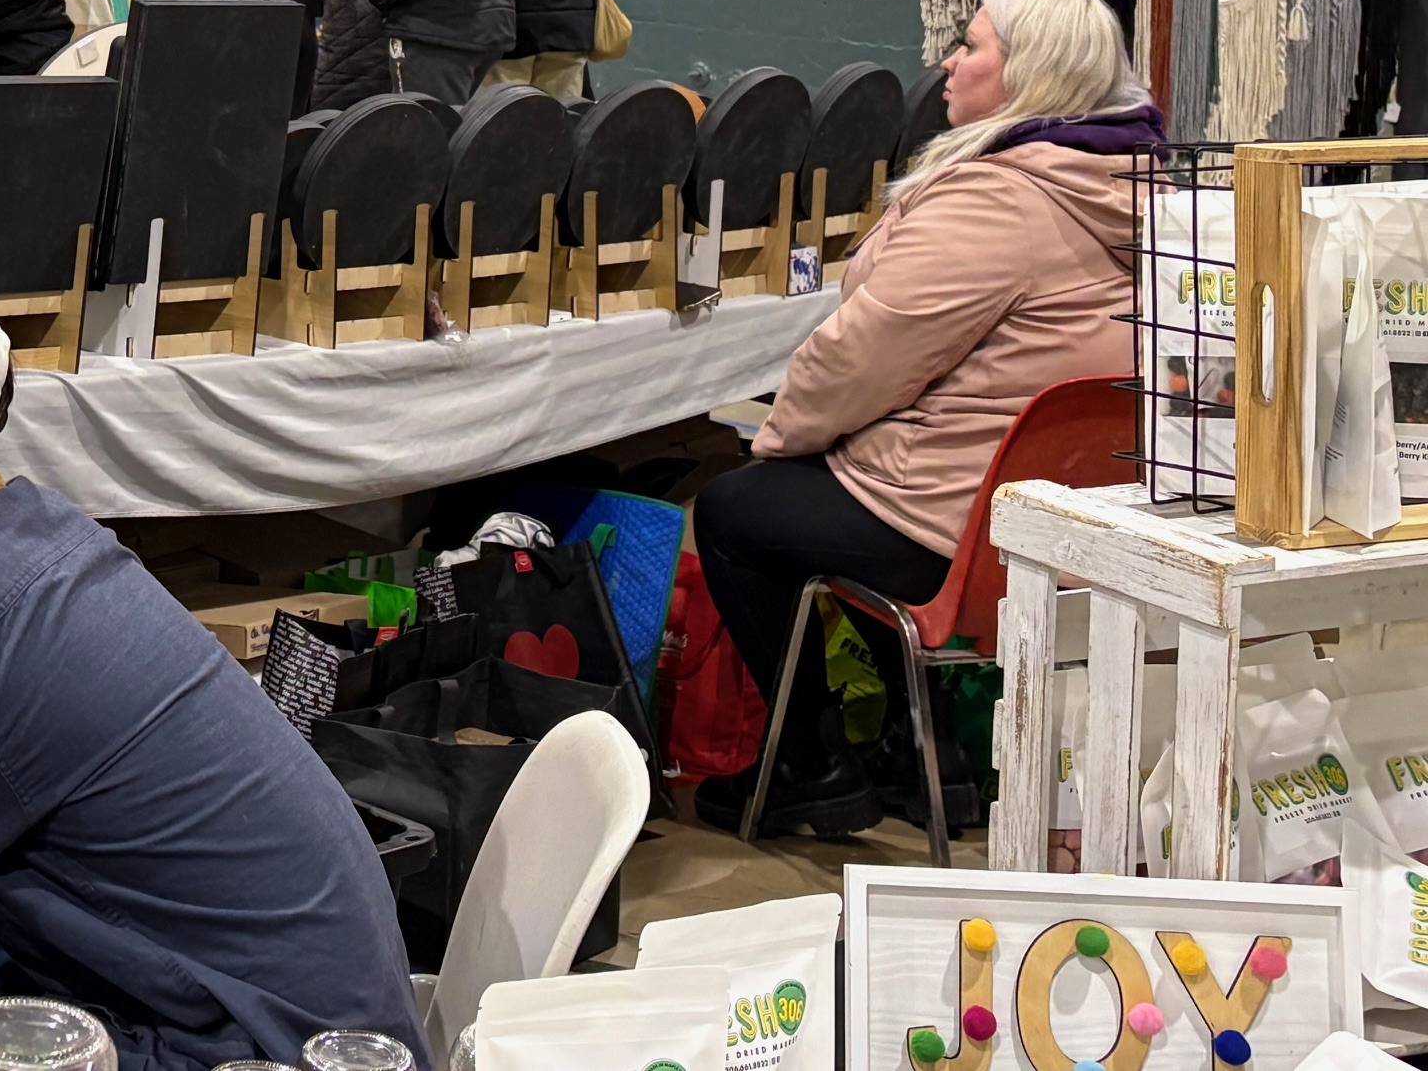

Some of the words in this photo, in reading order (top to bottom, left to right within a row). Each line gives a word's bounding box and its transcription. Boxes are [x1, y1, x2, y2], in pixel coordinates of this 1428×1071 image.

[1399, 451, 1420, 461] Berry
[1252, 763, 1331, 817] FRESH
[907, 918, 1293, 1071] JOY
[778, 997, 805, 1023] 306
[736, 1046, 767, 1059] DRIED
